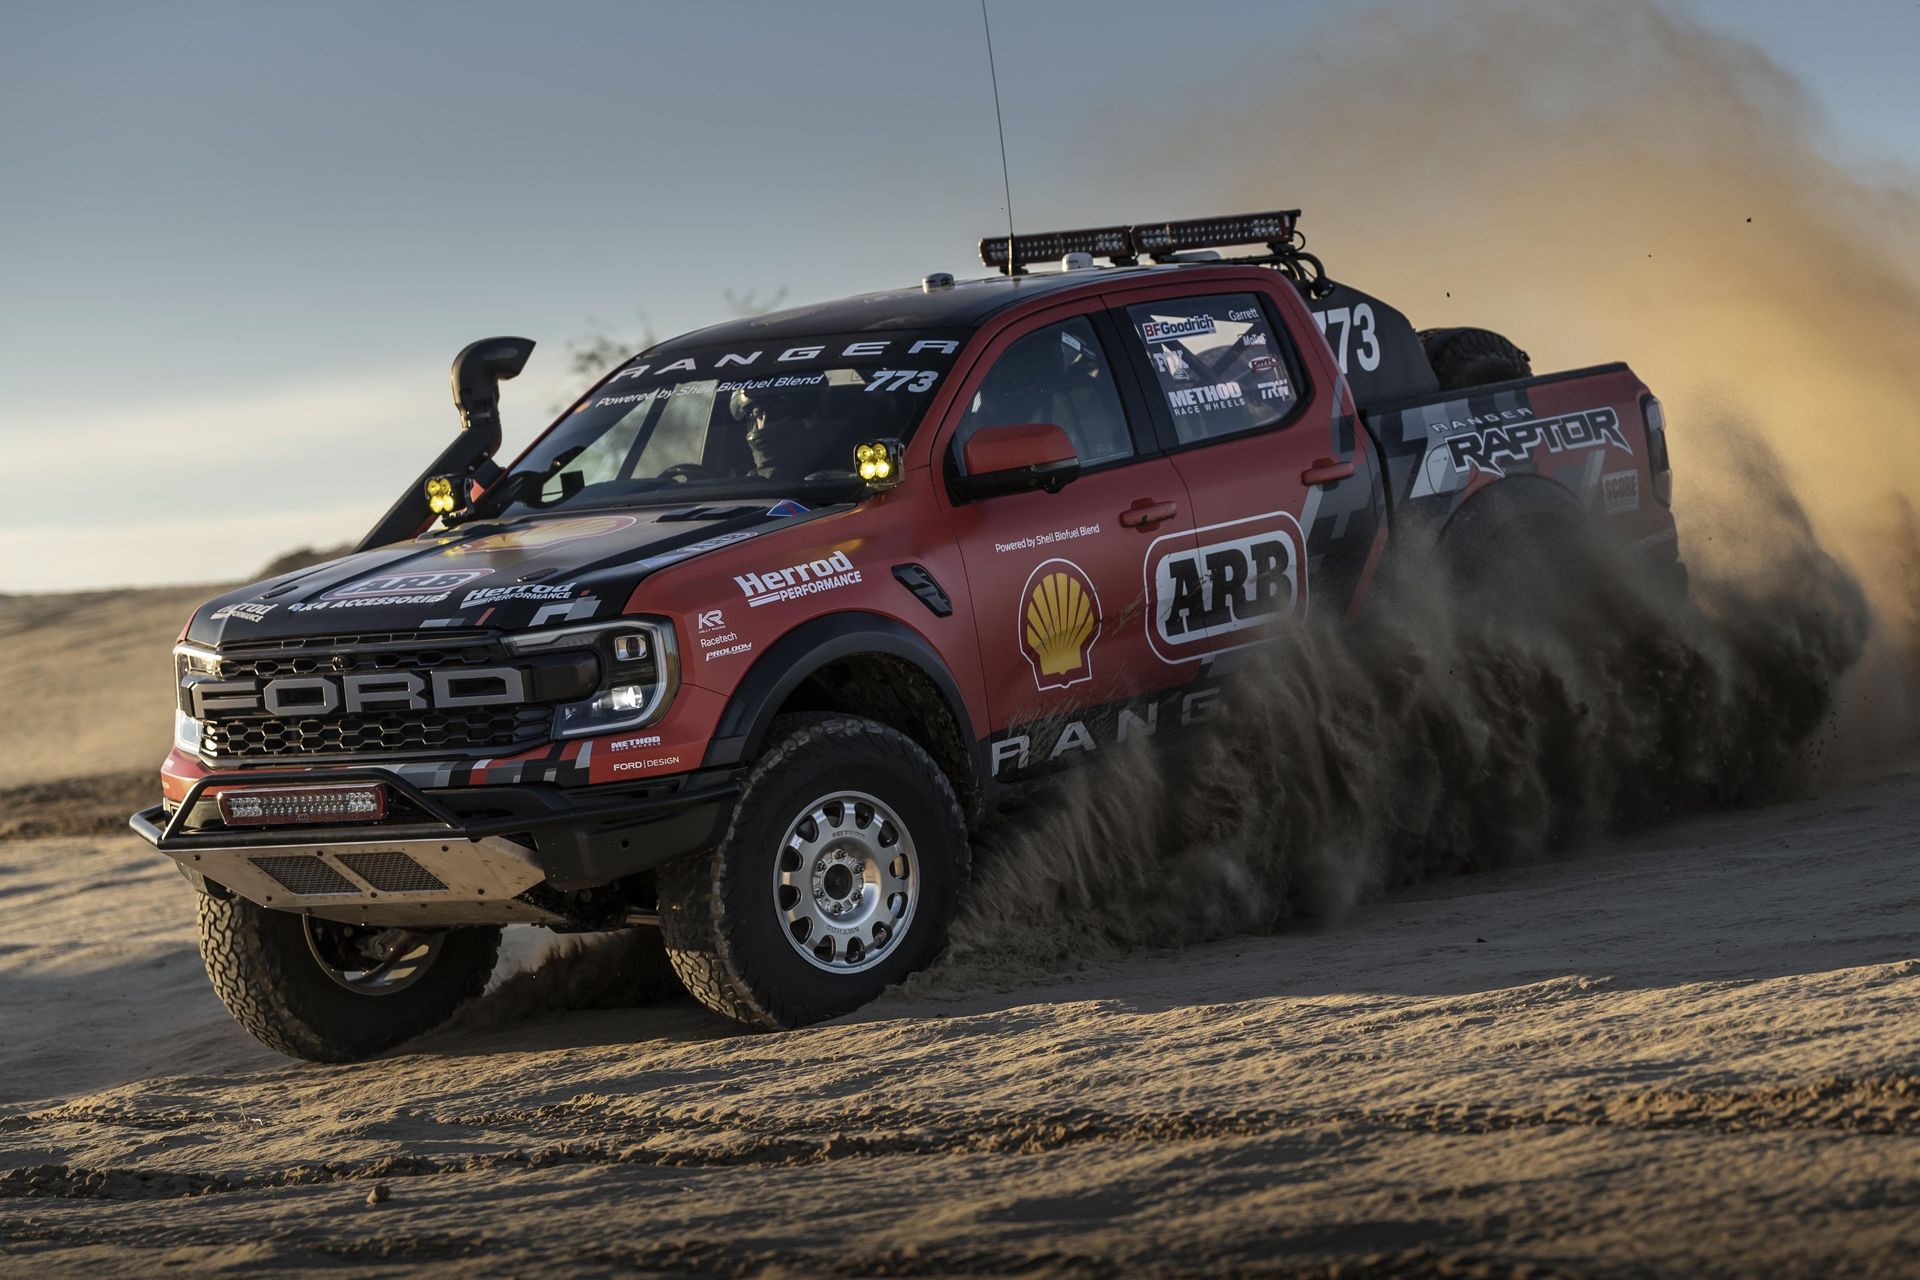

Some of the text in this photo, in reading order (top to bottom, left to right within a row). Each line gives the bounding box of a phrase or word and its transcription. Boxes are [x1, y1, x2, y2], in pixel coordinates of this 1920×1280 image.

[1144, 314, 1215, 337] BFGoodrich
[1228, 307, 1259, 321] Garrett
[608, 339, 961, 384] RANGER
[594, 391, 653, 407] Powered
[656, 388, 674, 400] by
[717, 378, 773, 393] Biofuel
[775, 374, 824, 386] Blend
[864, 370, 940, 393] 773
[1257, 379, 1289, 400] TRW
[1168, 381, 1242, 408] METHOD
[1175, 397, 1246, 416] RACE WHEELS
[1431, 407, 1534, 432] RANGER
[1445, 406, 1634, 478] RAPTOR
[995, 524, 1100, 552] Powered by Shell Biofuel Blend
[346, 574, 466, 592] ARB
[733, 550, 854, 597] Herrod
[464, 582, 576, 601] Herrod
[488, 591, 572, 603] PERFORMANCE
[779, 570, 862, 601] PERFORMANCE
[1165, 540, 1293, 637] ARB
[330, 592, 452, 607] ACCESSORIES
[698, 610, 724, 629] KR
[701, 632, 737, 648] Racetech
[706, 642, 752, 661] PROLOOM
[188, 667, 525, 718] FORD
[611, 736, 661, 748] METHOD
[991, 687, 1220, 777] RANG
[613, 757, 680, 771] FORD DESIGN
